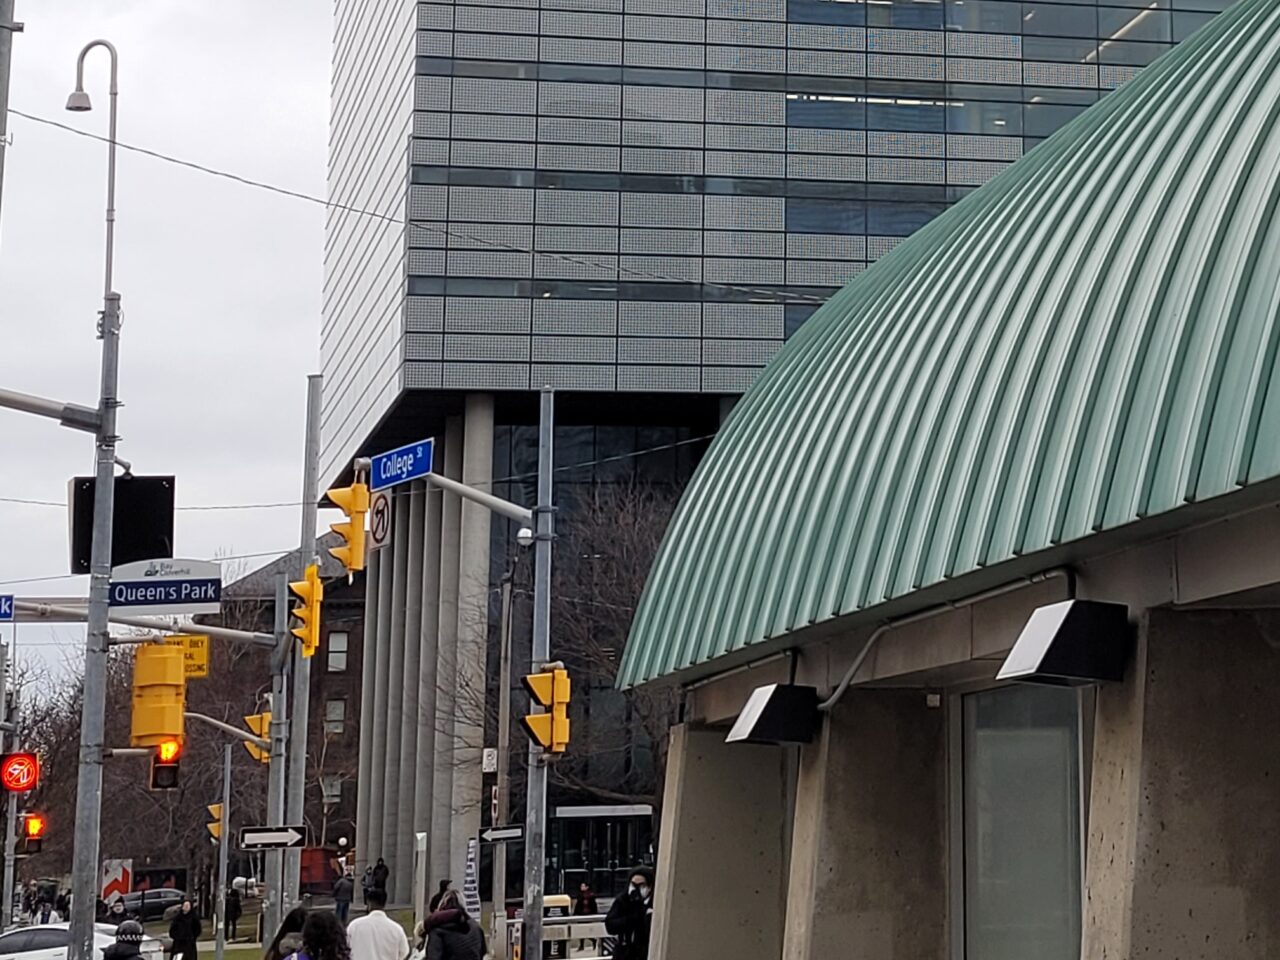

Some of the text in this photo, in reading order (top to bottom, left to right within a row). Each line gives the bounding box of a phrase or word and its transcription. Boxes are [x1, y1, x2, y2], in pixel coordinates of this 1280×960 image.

[380, 452, 414, 480] College
[114, 582, 216, 602] Queen's Park
